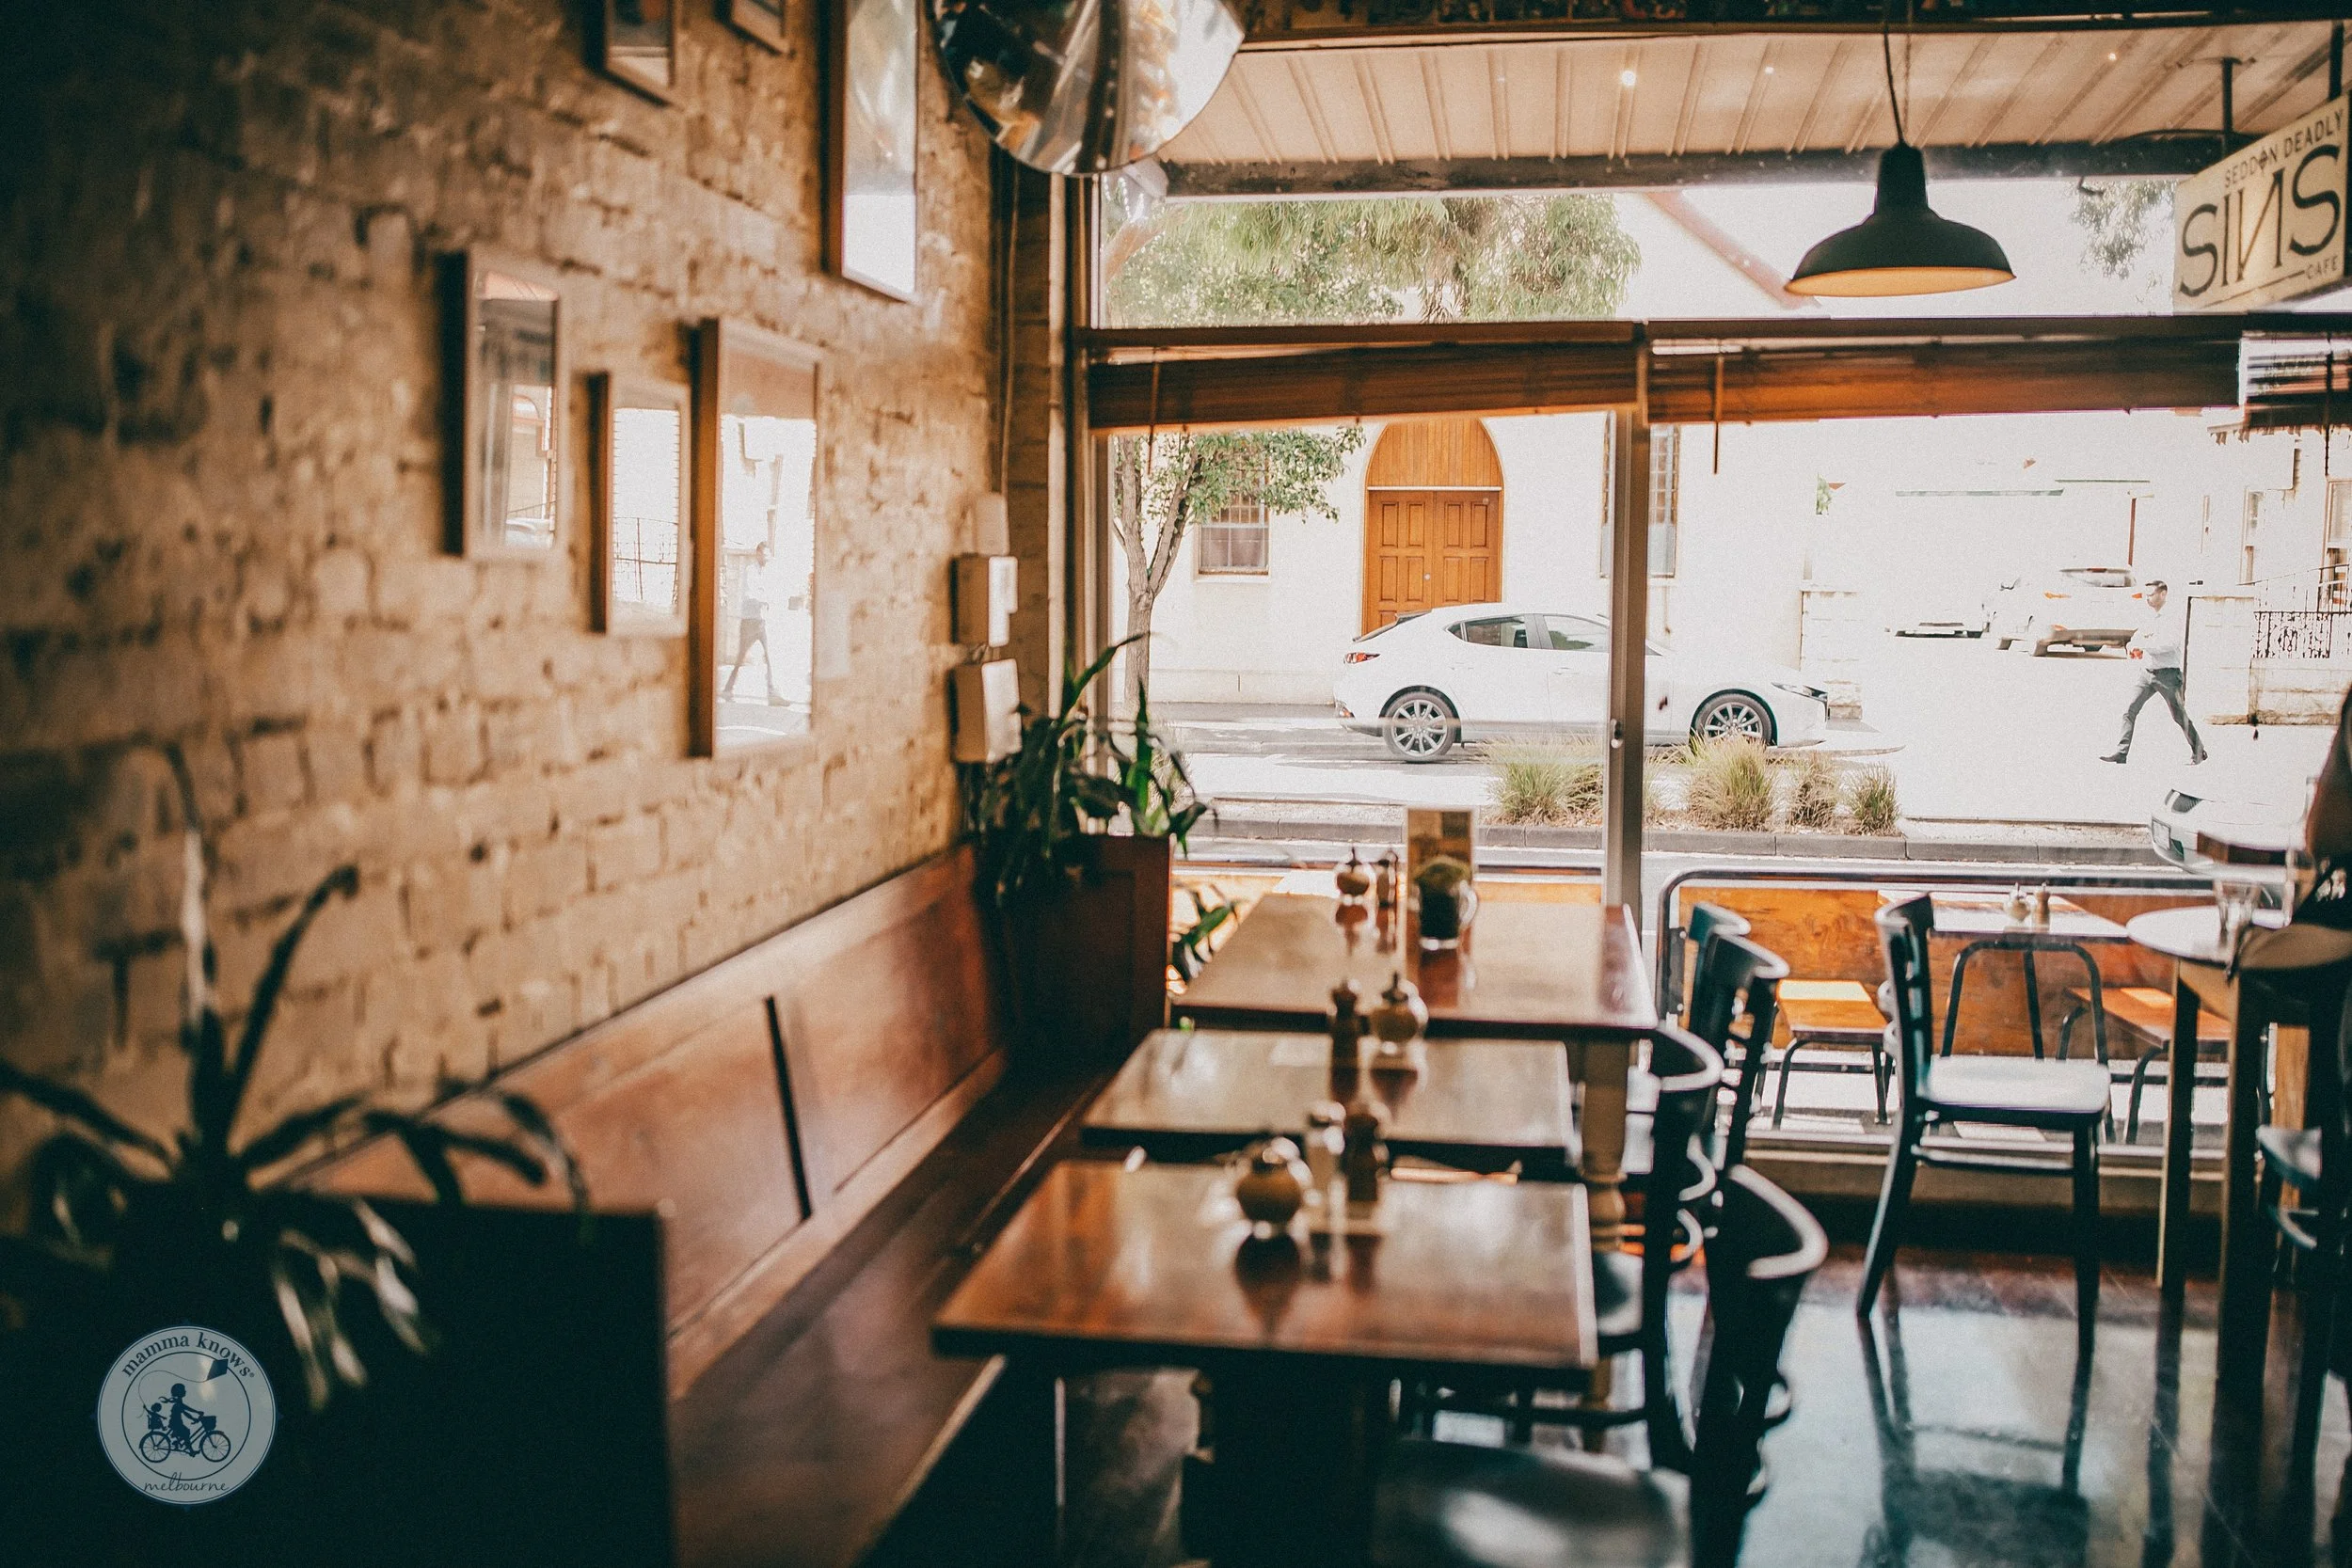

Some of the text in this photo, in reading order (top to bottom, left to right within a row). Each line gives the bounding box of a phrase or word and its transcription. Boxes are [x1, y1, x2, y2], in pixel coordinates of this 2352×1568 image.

[2224, 109, 2344, 188] SEDDON DEADLY
[2306, 255, 2339, 280] CAFE
